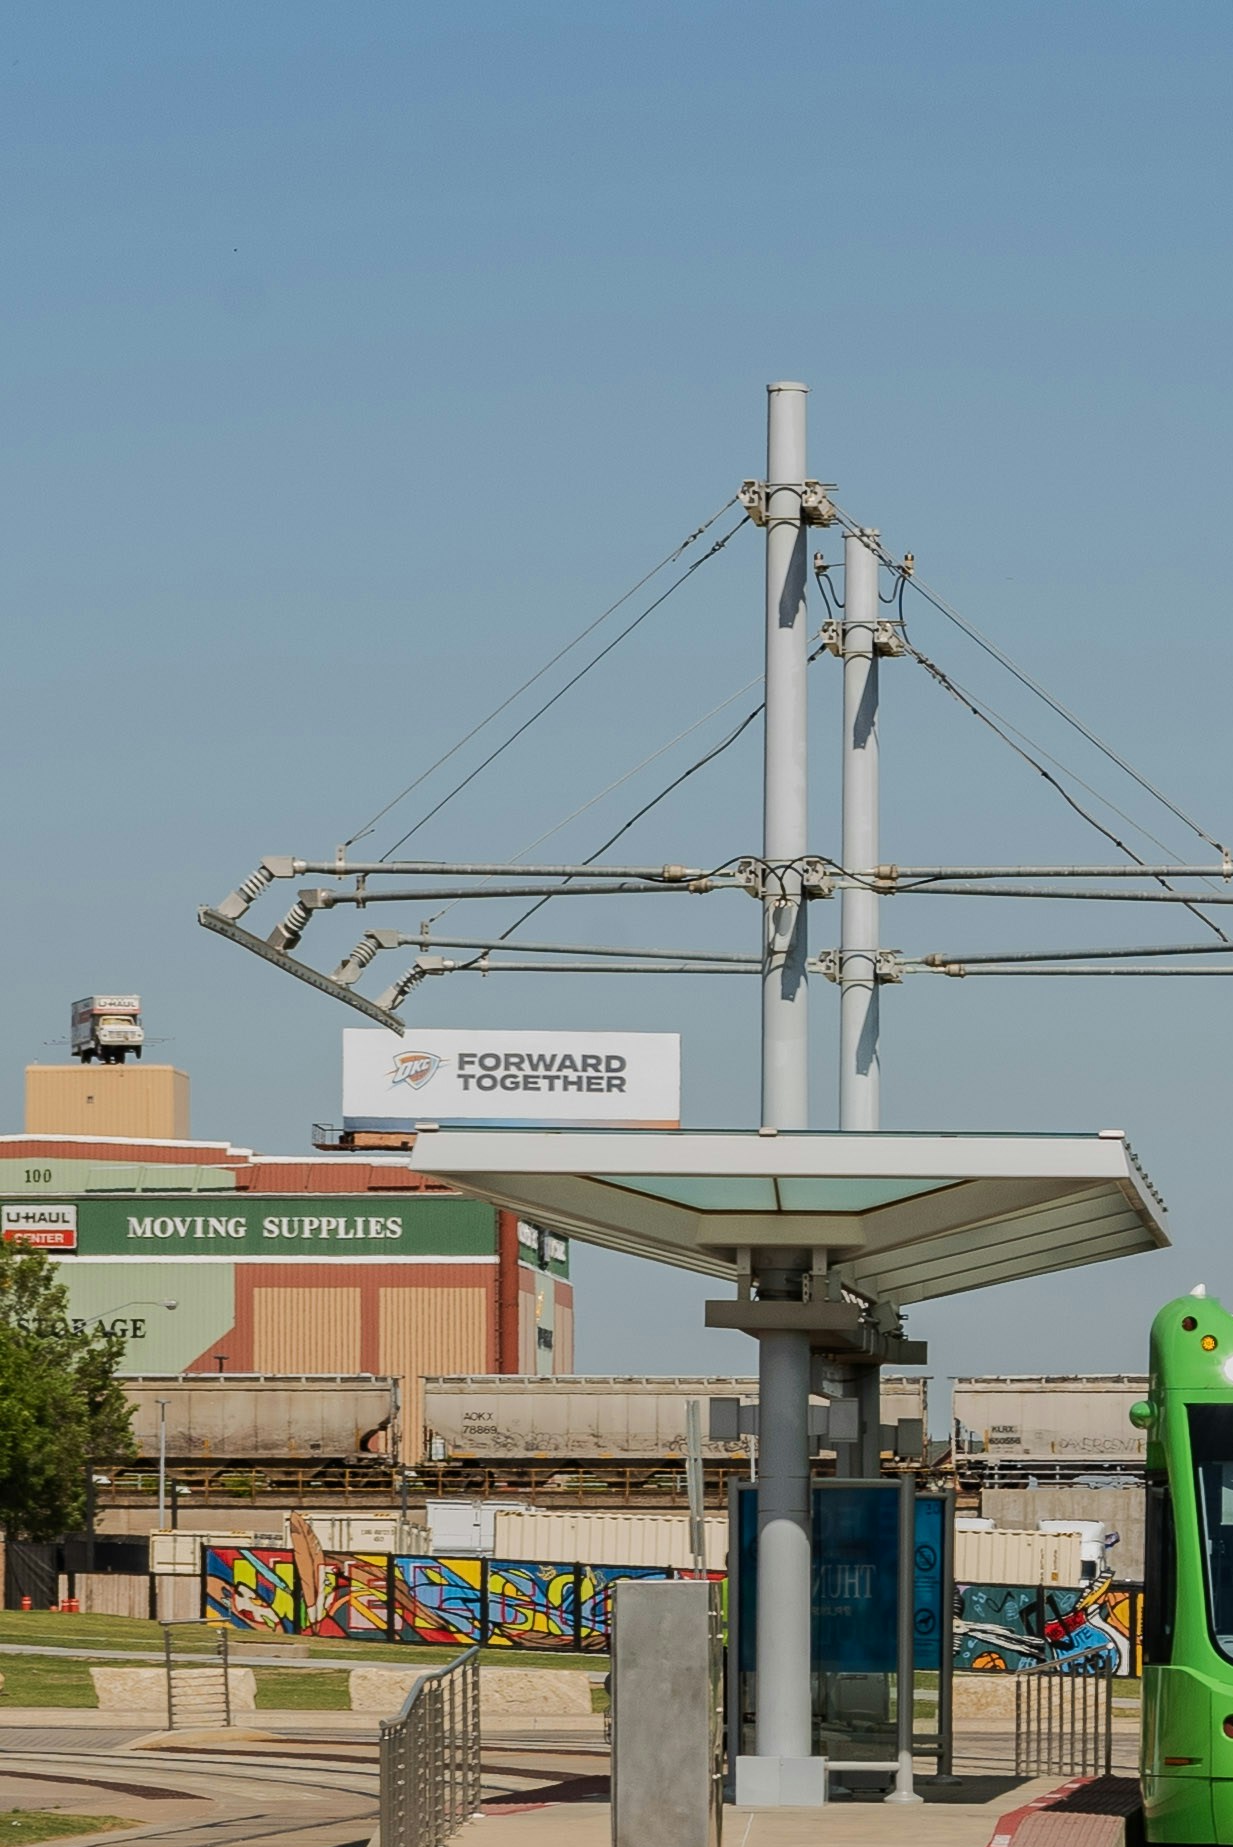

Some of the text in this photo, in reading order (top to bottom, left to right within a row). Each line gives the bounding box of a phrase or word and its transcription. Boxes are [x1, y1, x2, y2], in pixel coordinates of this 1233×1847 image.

[457, 1052, 627, 1073] FORWARD
[457, 1073, 627, 1093] TOGETHER
[25, 1169, 52, 1183] 100
[6, 1212, 70, 1224] U-HAUL
[127, 1216, 402, 1239] MOVING SUPPLIES
